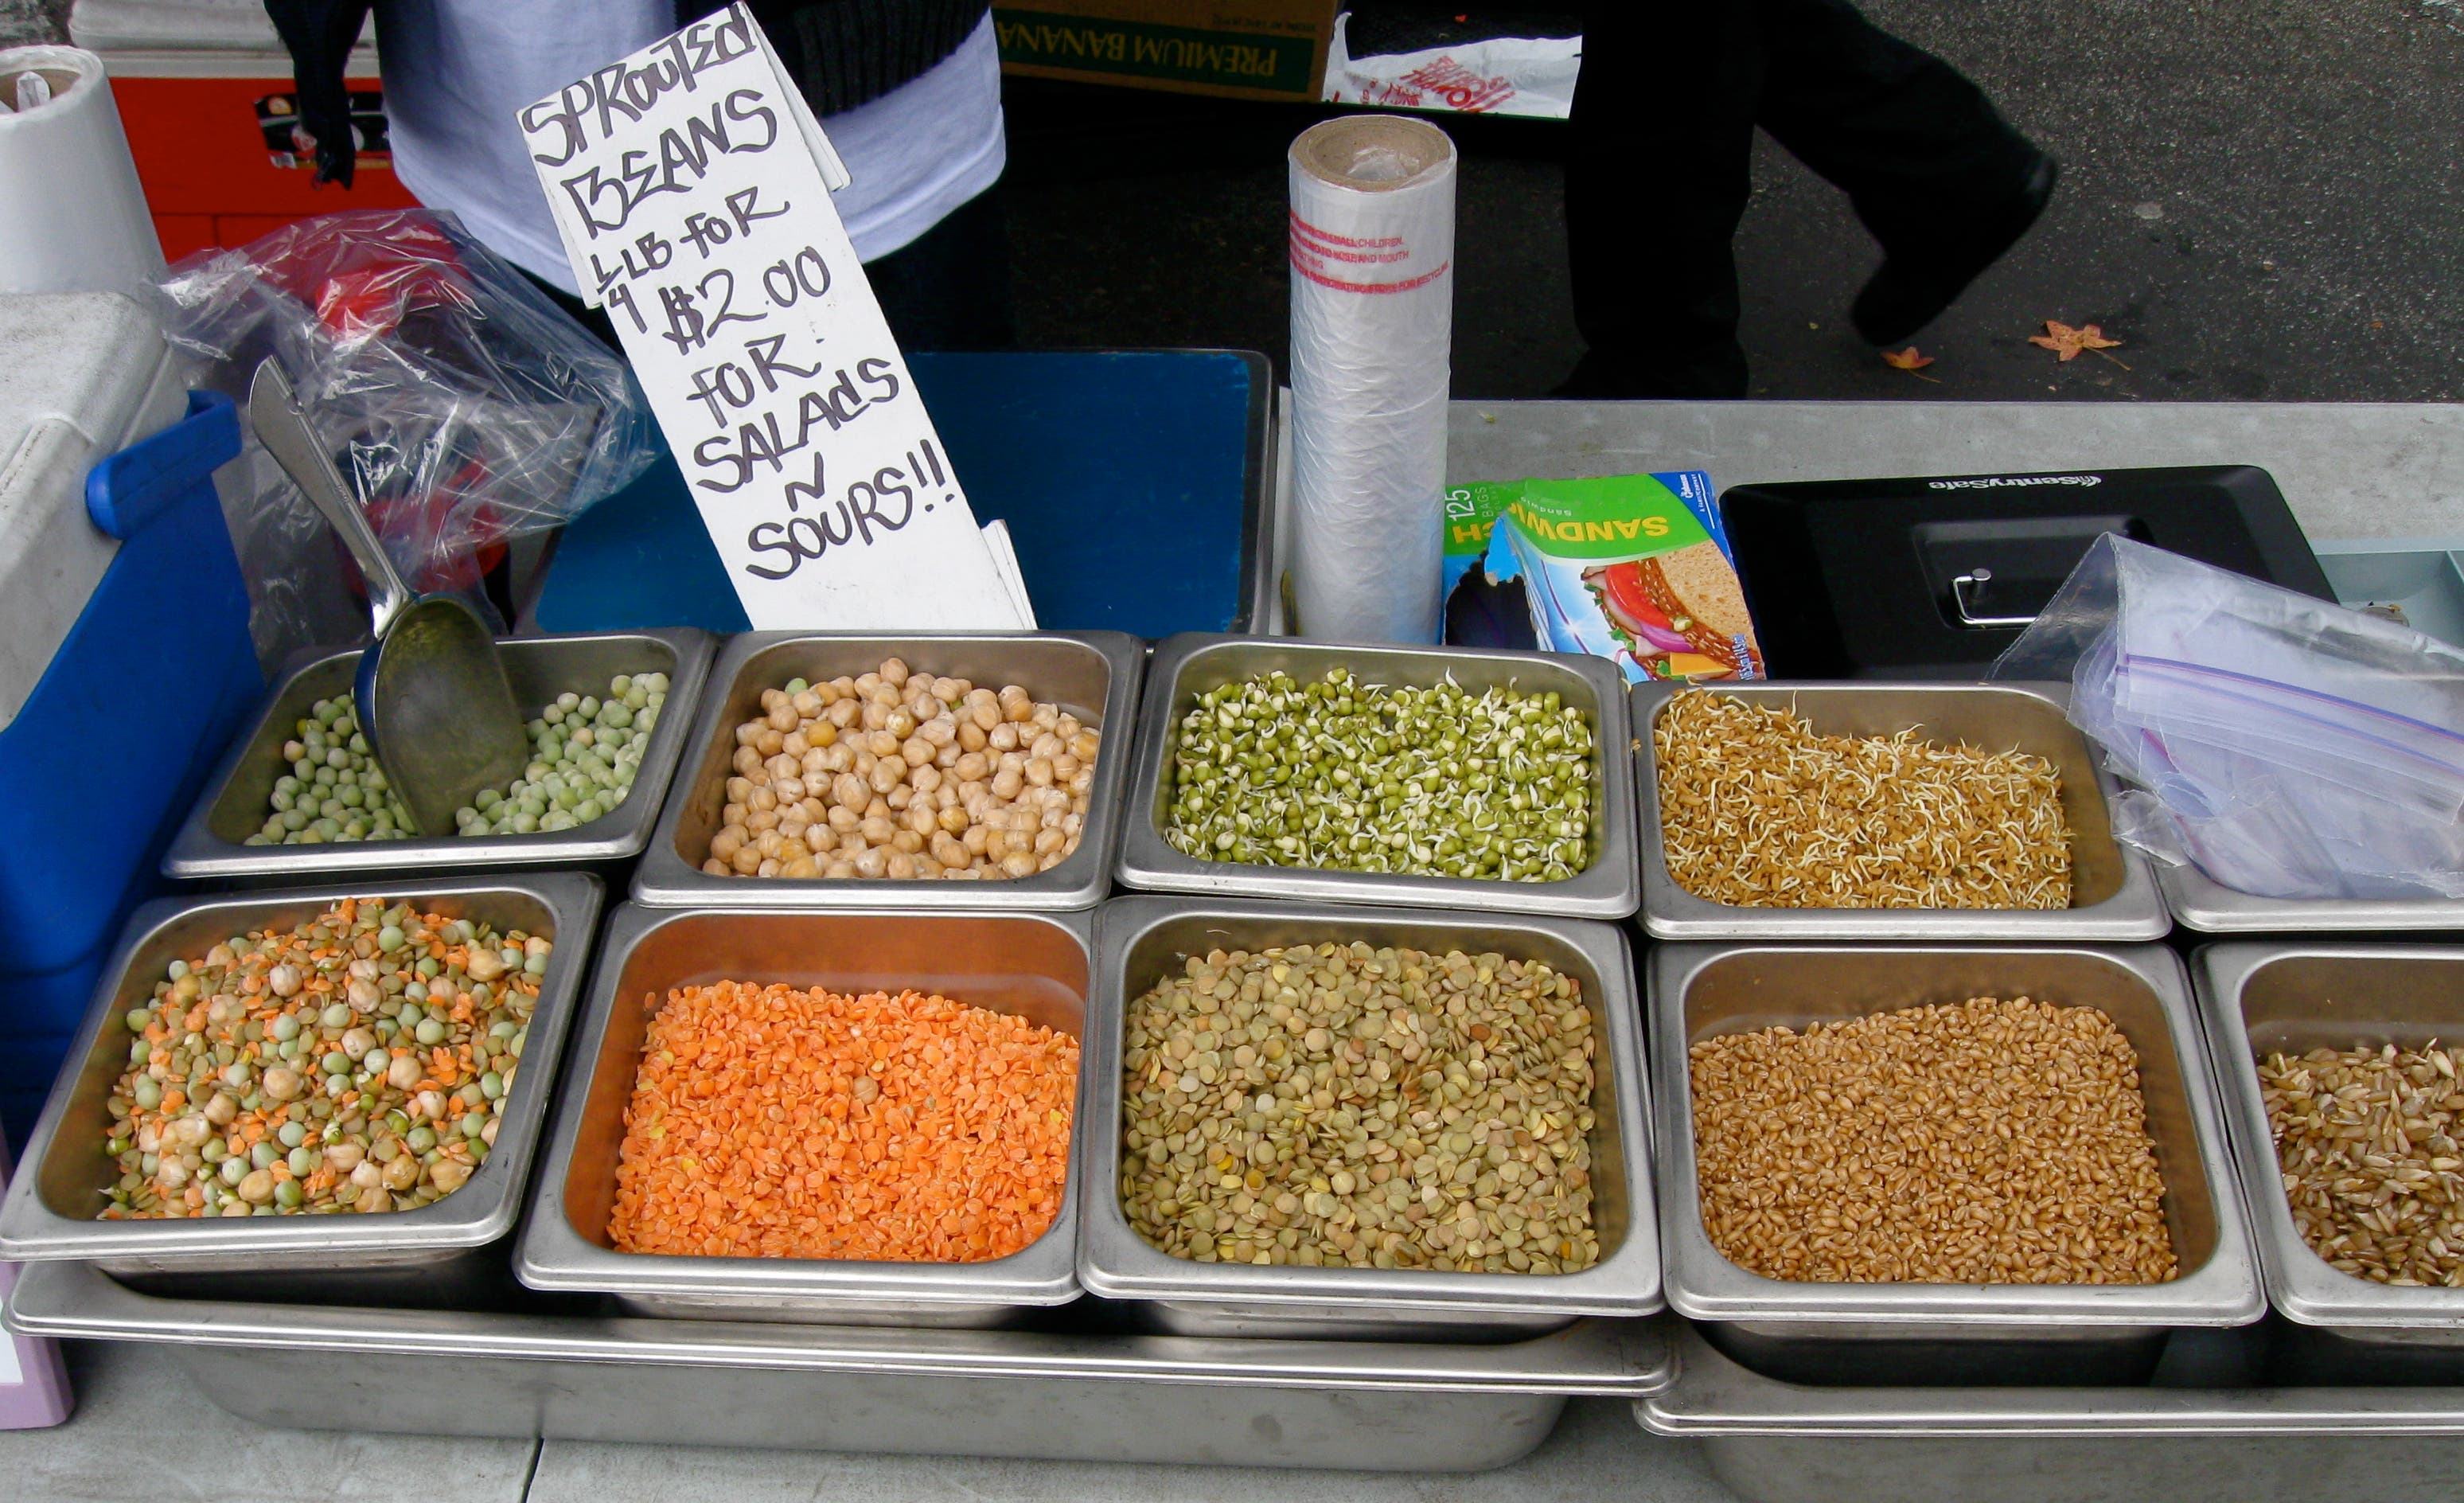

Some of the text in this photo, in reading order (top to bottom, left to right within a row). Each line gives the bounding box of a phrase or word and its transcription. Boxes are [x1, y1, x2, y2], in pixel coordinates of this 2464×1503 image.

[1134, 37, 1277, 76] PREMIUM
[560, 89, 778, 240] BEANS
[1378, 251, 1409, 264] MOUTH
[657, 246, 831, 356] $2.00
[784, 451, 825, 512] N
[1928, 475, 2084, 490] SentrySafe
[1444, 489, 1476, 521] 125
[1475, 486, 1495, 518] BAGS
